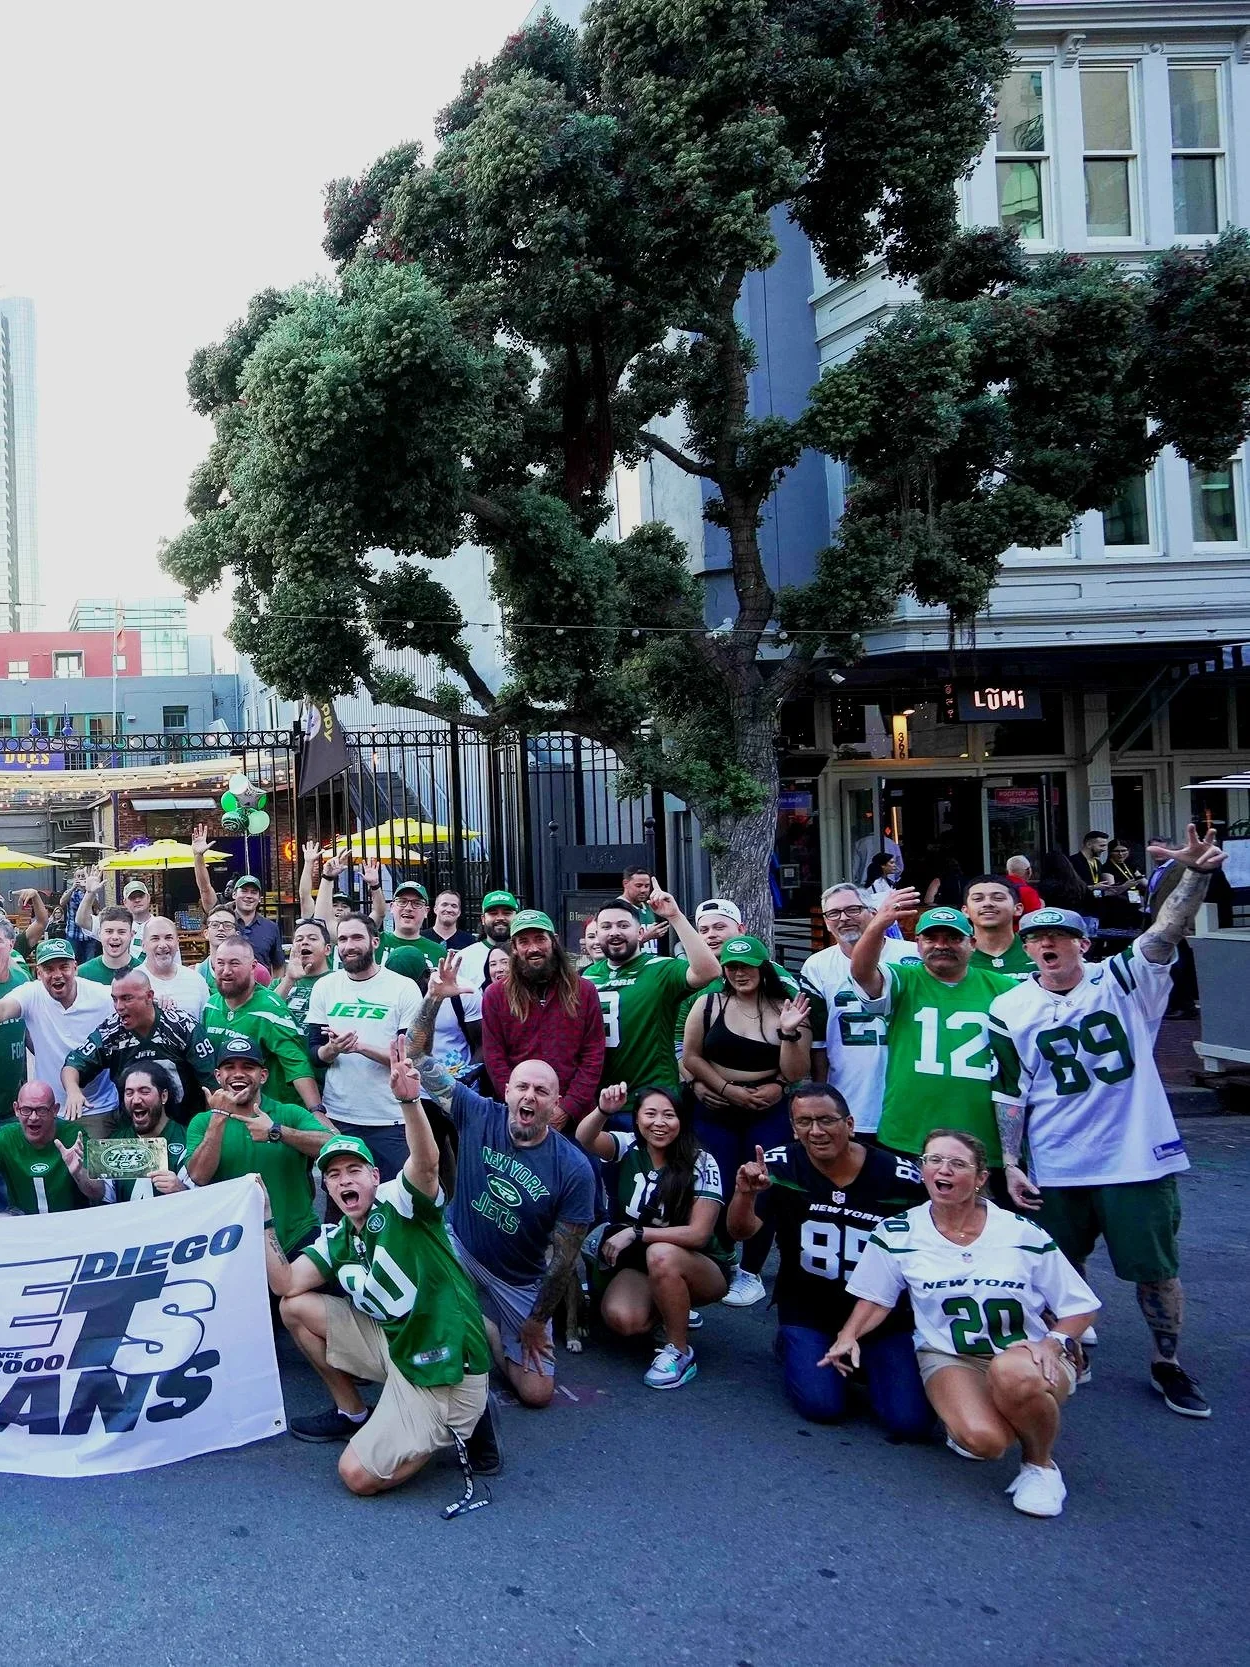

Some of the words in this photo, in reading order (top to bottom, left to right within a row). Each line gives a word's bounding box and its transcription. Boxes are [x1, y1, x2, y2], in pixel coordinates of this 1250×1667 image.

[327, 1002, 390, 1020] JETS
[206, 1026, 226, 1037] NEW
[195, 1038, 215, 1058] 99
[913, 1006, 992, 1081] 12
[1035, 1010, 1136, 1096] 89
[135, 1050, 156, 1059] JETS
[108, 1153, 145, 1162] JETS
[482, 1146, 511, 1173] NEW
[509, 1160, 550, 1202] YORK
[705, 1169, 719, 1187] 15
[470, 1192, 520, 1234] JETS
[809, 1203, 842, 1214] NEW
[843, 1207, 885, 1223] YORK
[78, 1223, 244, 1282] DIEGO
[336, 1244, 419, 1321] 80
[922, 1278, 969, 1290] NEW
[973, 1278, 1026, 1290] YORK
[941, 1296, 1029, 1355] 20
